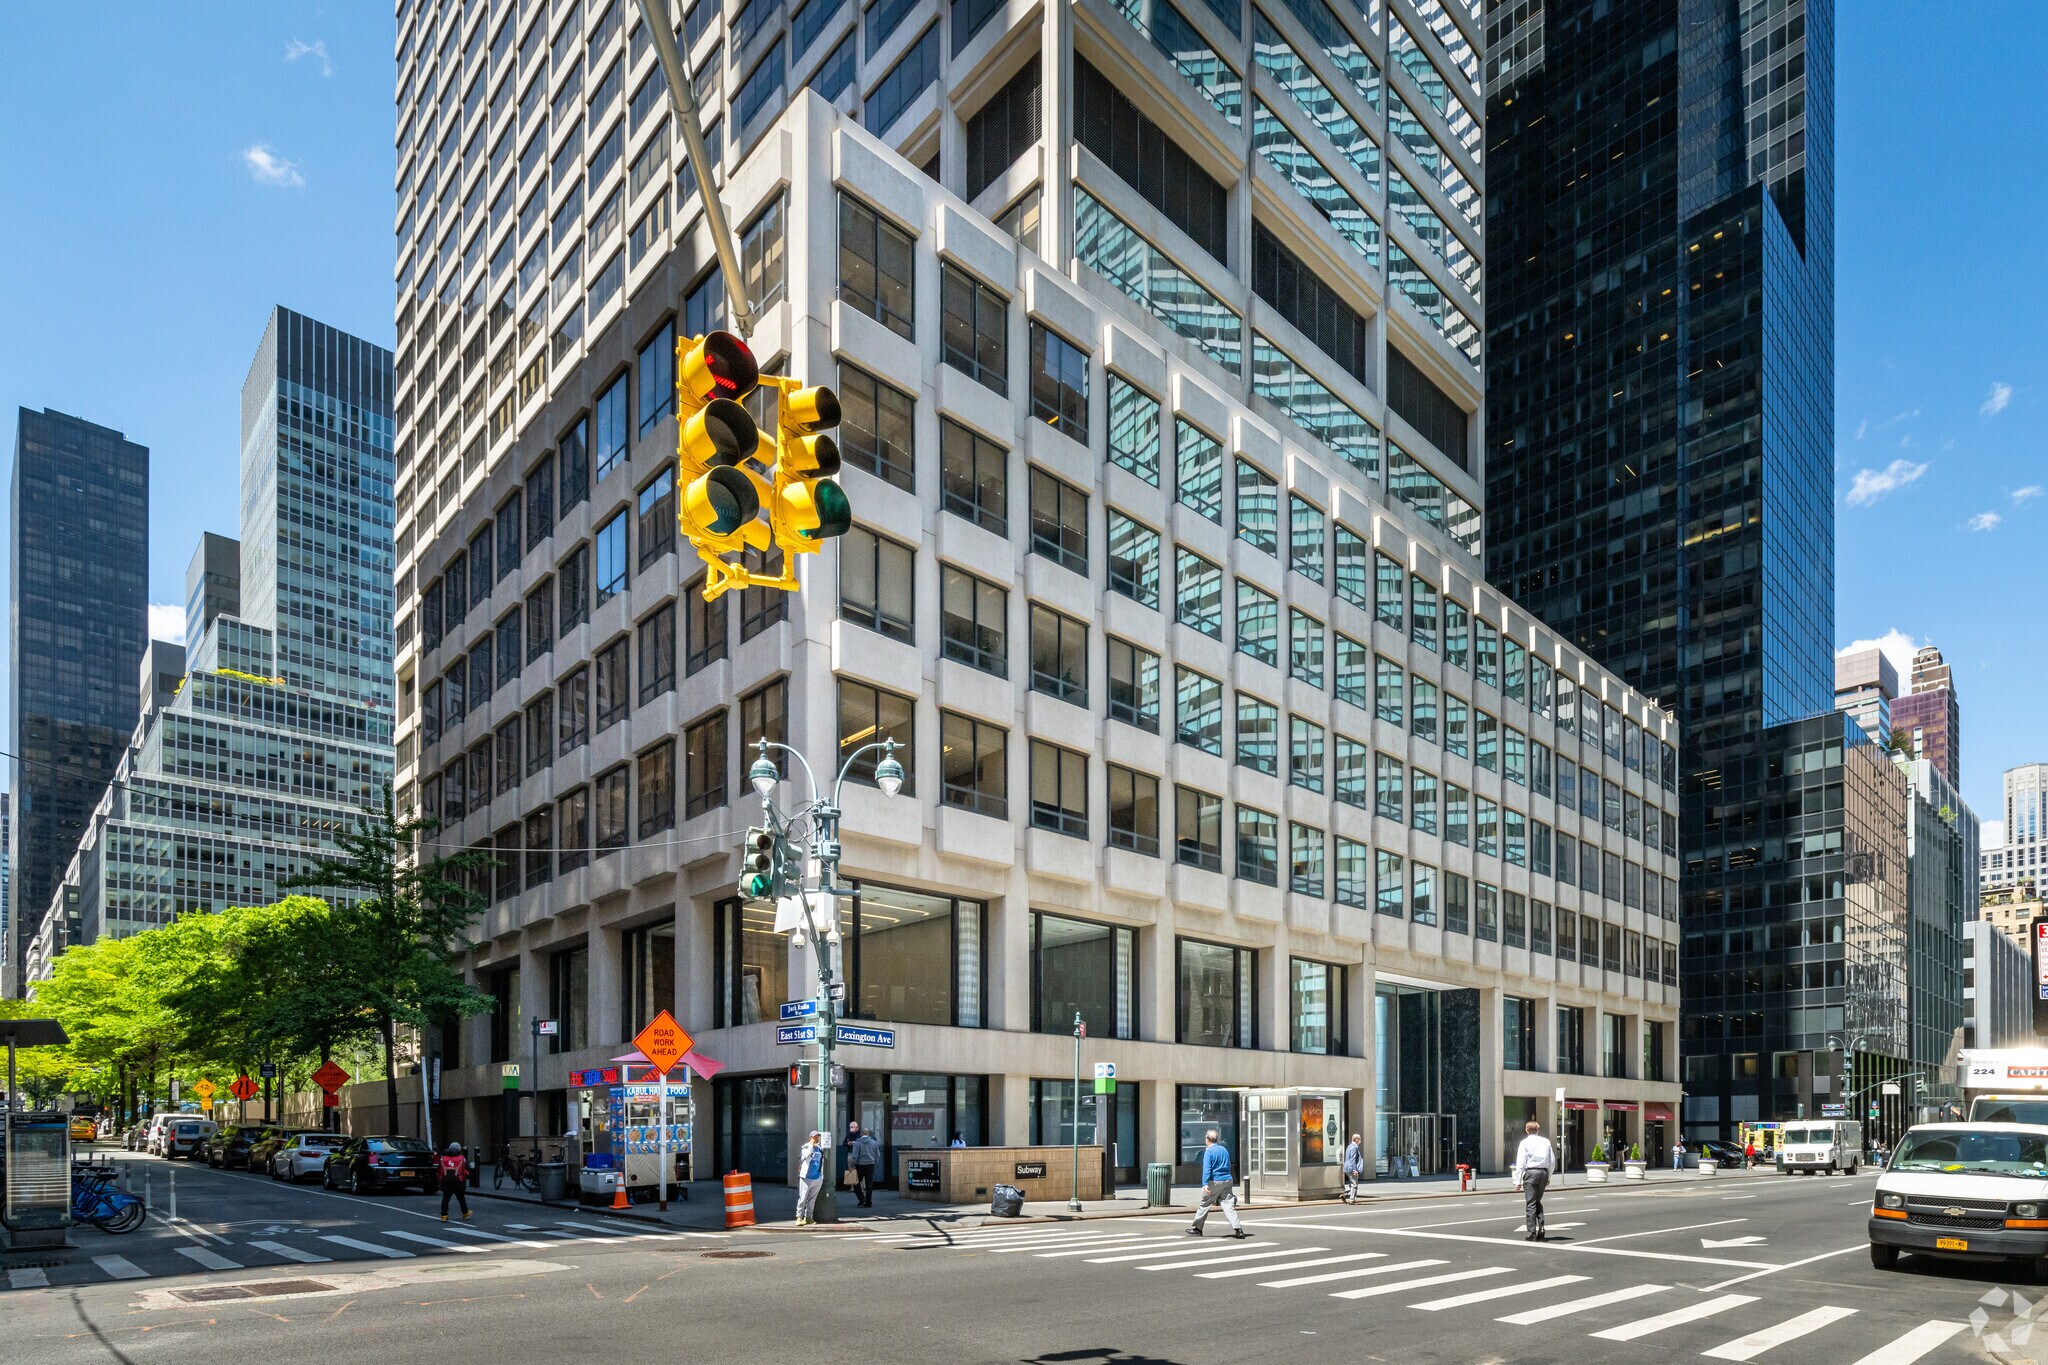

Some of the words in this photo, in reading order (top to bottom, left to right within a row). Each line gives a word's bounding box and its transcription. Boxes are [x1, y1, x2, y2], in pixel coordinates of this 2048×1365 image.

[780, 1031, 793, 1040] East
[794, 1031, 806, 1039] 51st
[806, 1030, 814, 1038] St
[839, 1029, 876, 1043] Lexington
[877, 1034, 891, 1044] Ave
[651, 1048, 677, 1056] AHEAD
[627, 1086, 648, 1096] KABUL
[649, 1086, 669, 1095] HAL
[671, 1086, 688, 1095] FOOD
[1017, 1165, 1042, 1176] Subway
